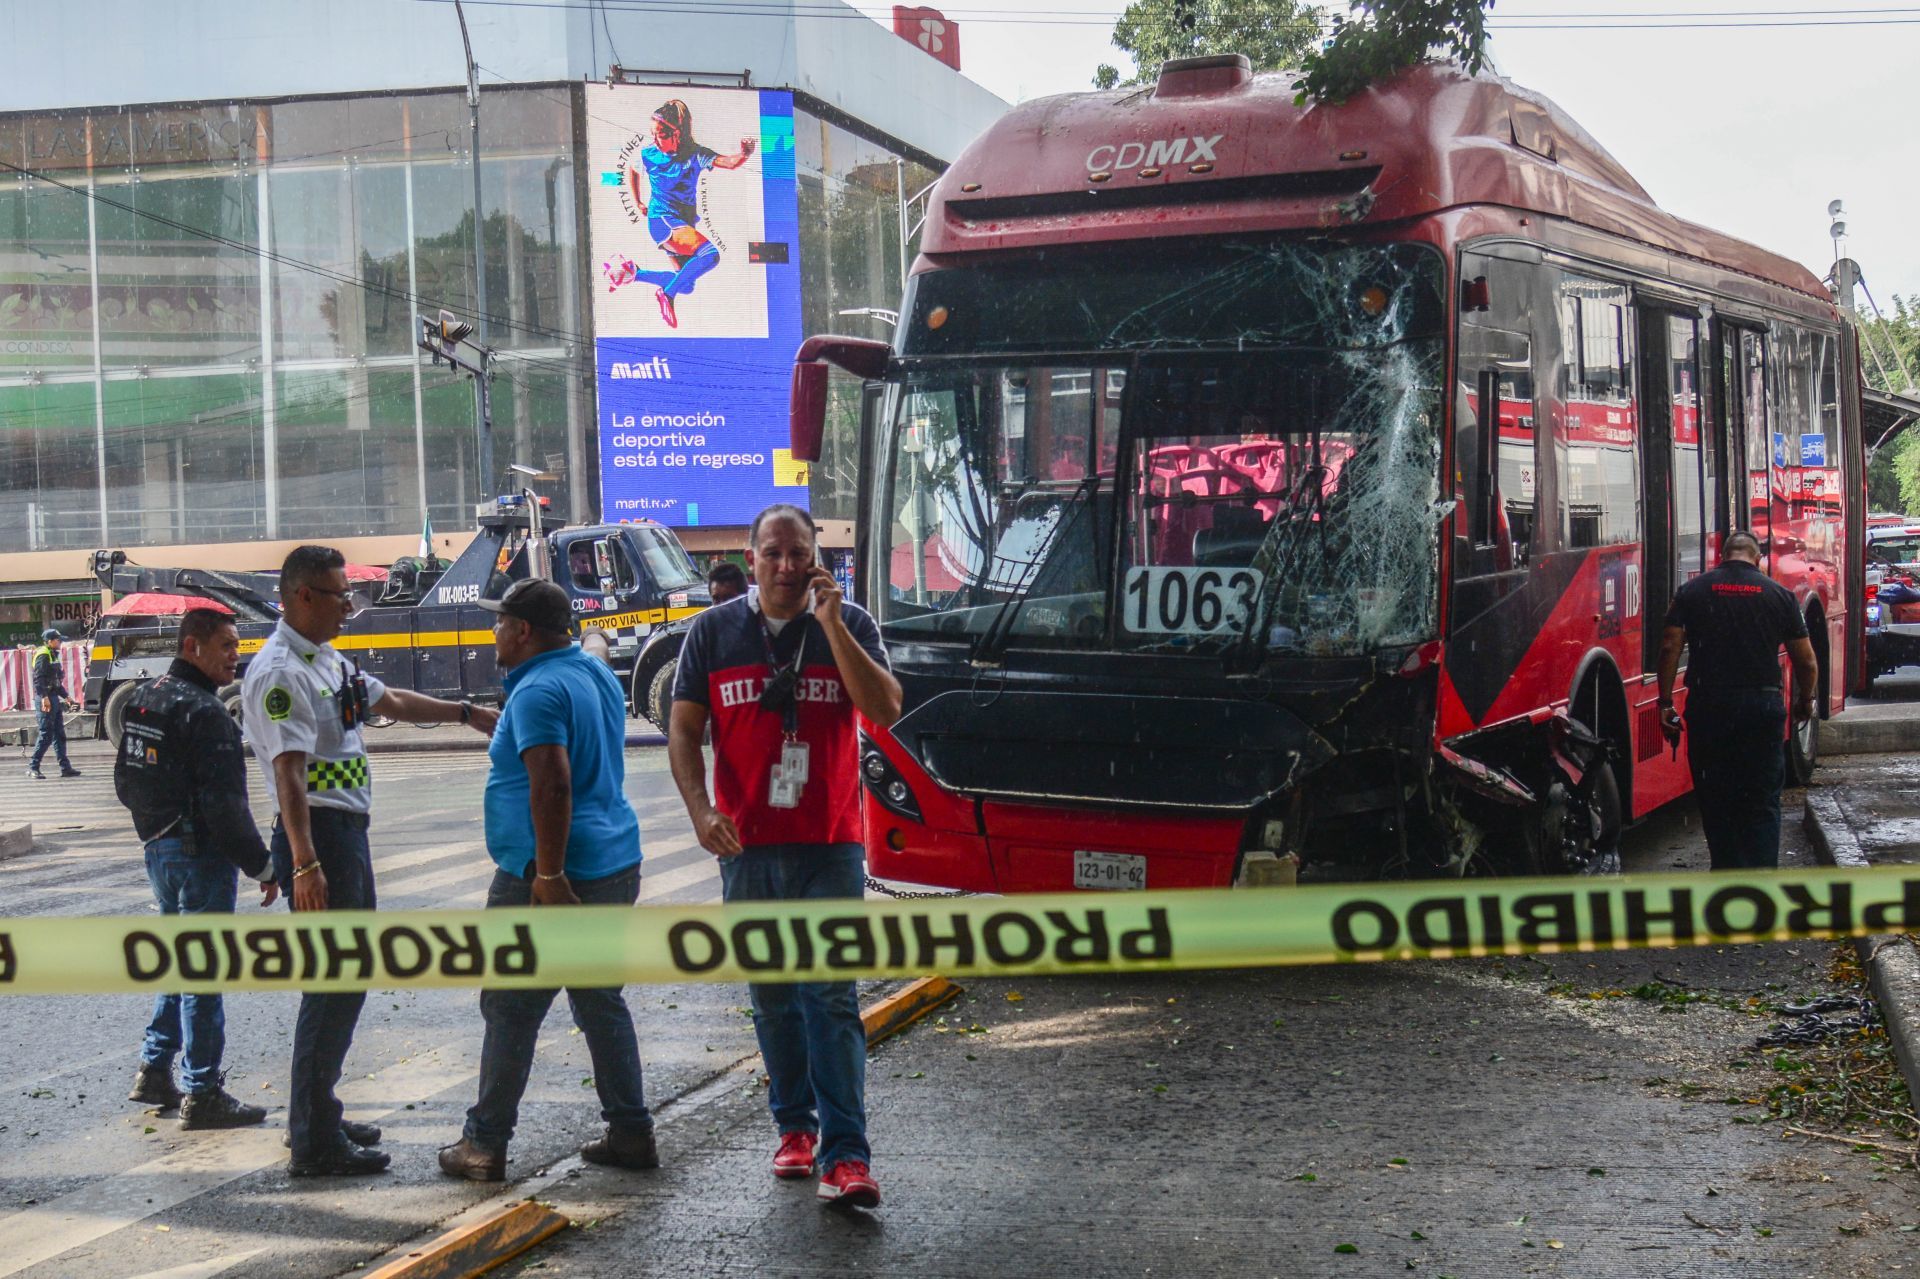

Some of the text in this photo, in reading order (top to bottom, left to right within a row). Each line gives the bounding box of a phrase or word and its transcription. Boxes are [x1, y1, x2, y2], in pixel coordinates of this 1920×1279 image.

[1086, 134, 1224, 172] CDMX
[616, 134, 645, 225] KATTY MARTÍNEZ
[6, 341, 75, 354] CONDESA
[612, 411, 726, 428] La emoción
[612, 432, 706, 450] deportiva
[613, 451, 765, 469] está de regreso
[438, 584, 480, 604] MX-003-E5
[1129, 570, 1257, 632] 1063
[619, 614, 642, 626] VIAL
[719, 678, 841, 708] HILGER
[1078, 863, 1144, 883] 123-01-62
[122, 880, 1920, 983] PROHIBIDO PROHIBIDO PROHIBIDO
